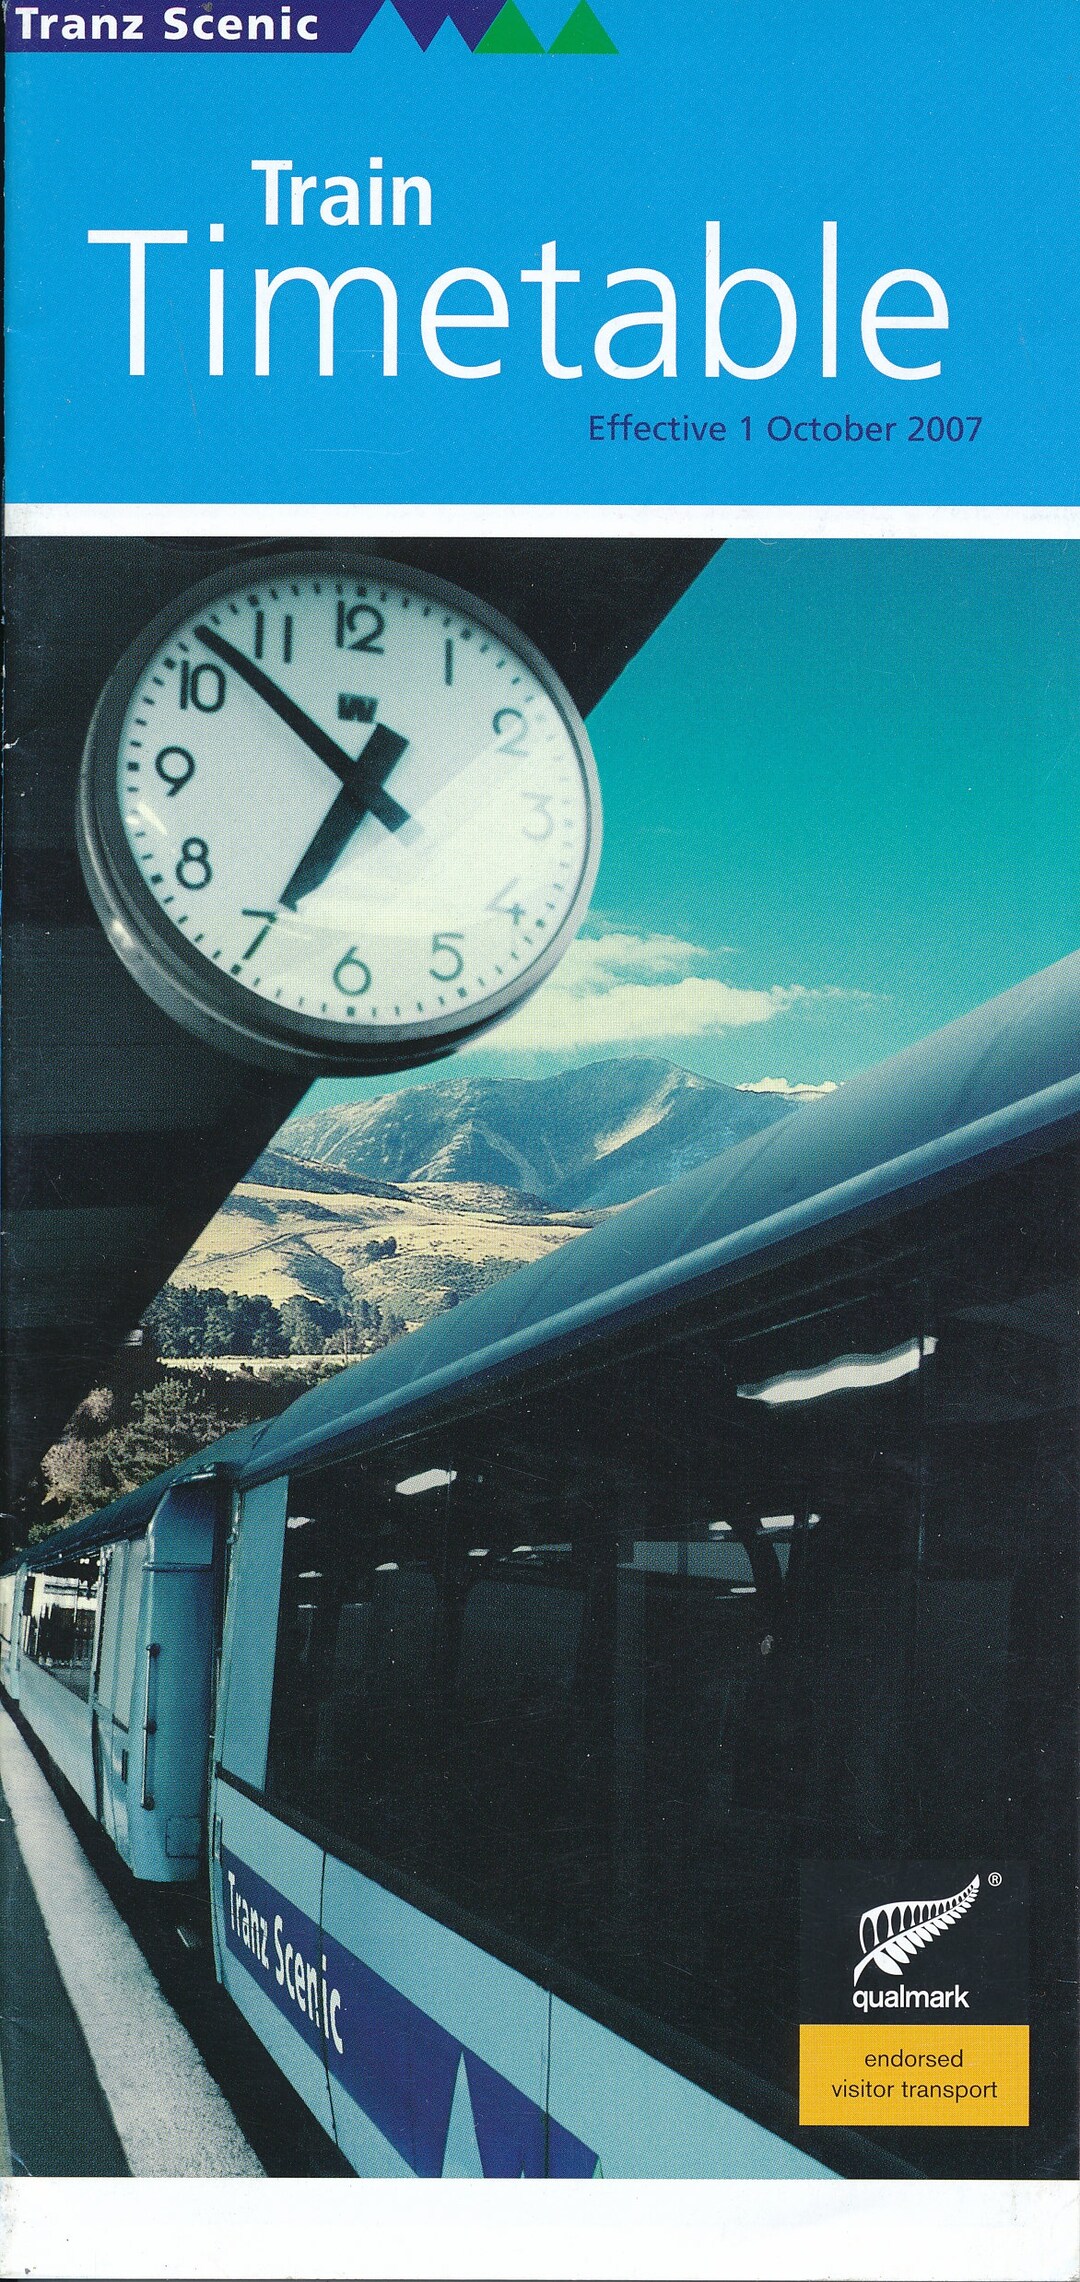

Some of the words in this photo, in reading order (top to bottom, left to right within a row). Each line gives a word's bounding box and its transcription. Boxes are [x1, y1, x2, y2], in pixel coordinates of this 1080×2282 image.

[14, 6, 145, 42] Tranz
[162, 5, 320, 42] Scenic
[251, 156, 433, 227] Train
[88, 220, 951, 380] Timetable
[588, 413, 727, 443] Effective
[740, 415, 753, 442] 1
[766, 413, 897, 443] October
[908, 415, 984, 443] 2007
[255, 610, 292, 664] 11
[336, 600, 385, 654] 12
[180, 659, 227, 713] 10
[444, 638, 454, 686] 1
[492, 708, 530, 757] 2
[155, 746, 195, 797] 9
[521, 791, 554, 842] 3
[175, 837, 213, 891] 8
[485, 877, 526, 924] 4
[242, 908, 278, 960] 7
[428, 932, 465, 982] 5
[332, 945, 372, 997] 6
[227, 1870, 270, 1970] Tranz
[273, 1914, 344, 2055] Scenic
[852, 1984, 970, 2013] qualmark
[864, 2049, 963, 2068] endorsed
[831, 2079, 895, 2098] visitor
[901, 2080, 998, 2103] transport
